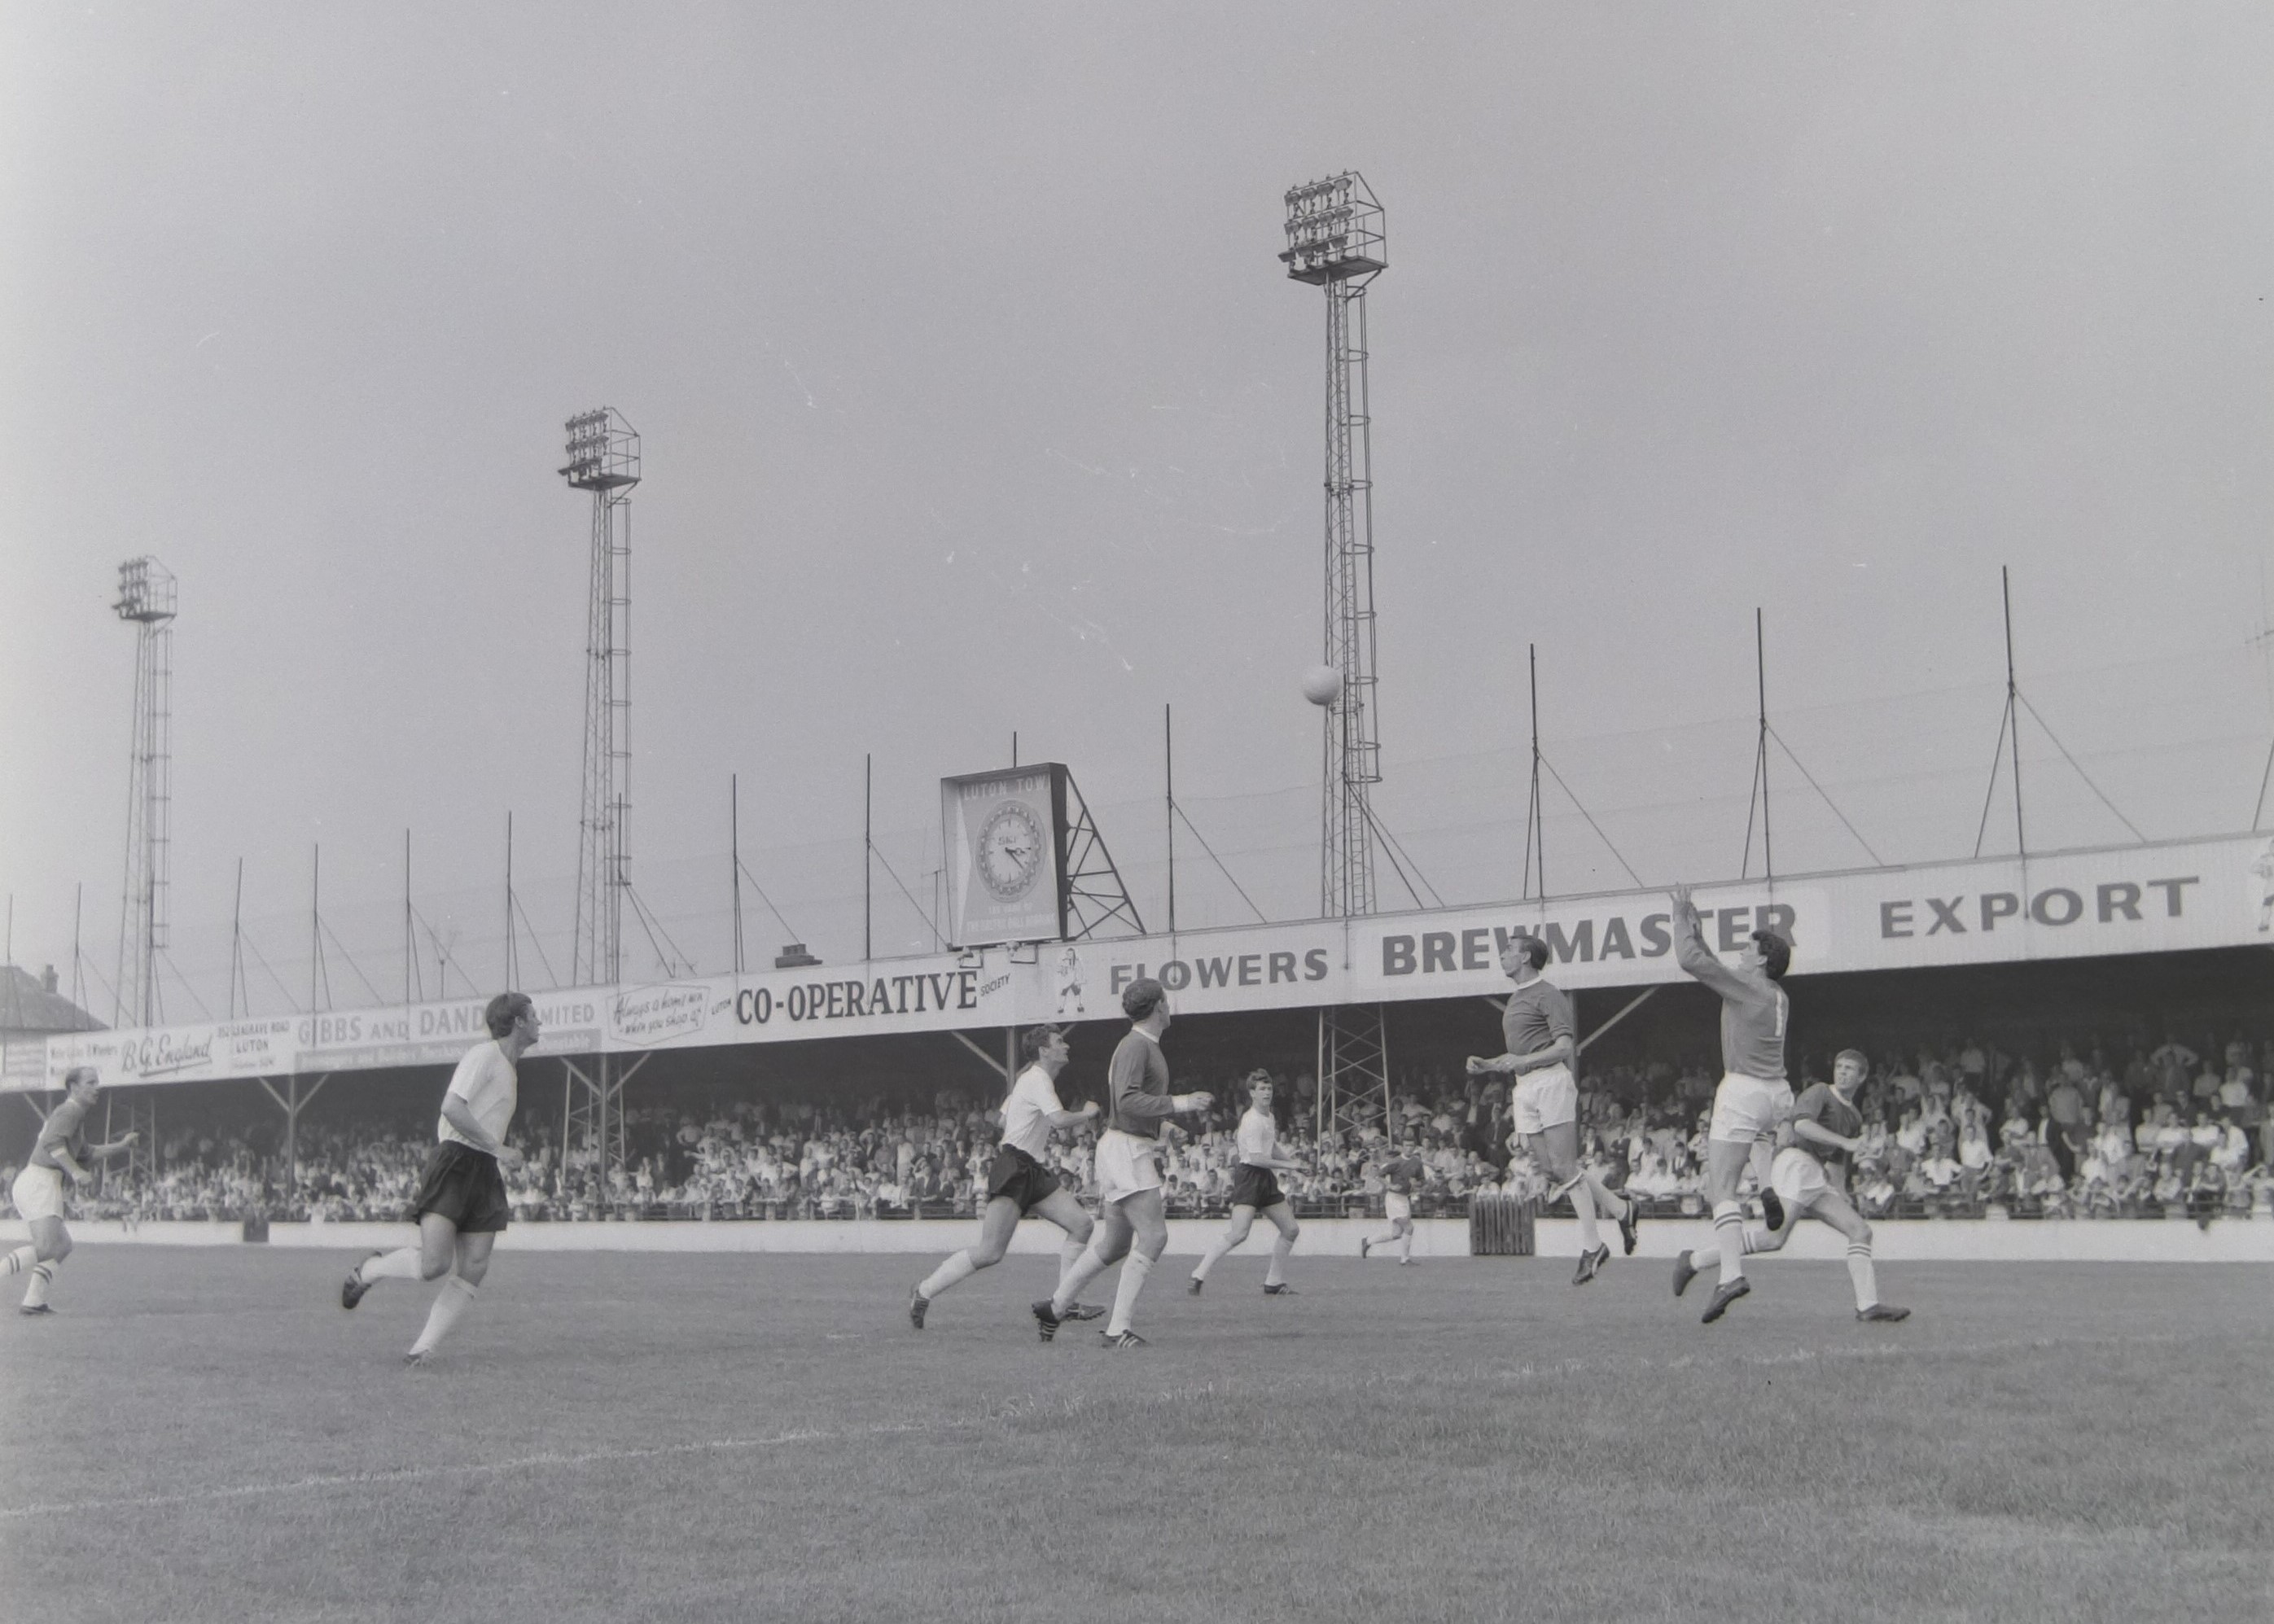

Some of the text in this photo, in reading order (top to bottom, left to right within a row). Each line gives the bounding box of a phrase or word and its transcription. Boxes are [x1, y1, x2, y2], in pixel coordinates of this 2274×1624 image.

[964, 781, 1007, 801] LUTON
[1382, 904, 1797, 977] BREMASER
[1881, 876, 2200, 939] EXPORT
[712, 970, 1010, 1025] LUTON CO-OPERATIVE SOCIETY
[1775, 991, 1783, 1036] 1
[370, 1021, 410, 1040] AND
[420, 1005, 486, 1035] DAND
[541, 1003, 594, 1026] MITED
[156, 1033, 213, 1075] England
[236, 1039, 269, 1053] LUTON
